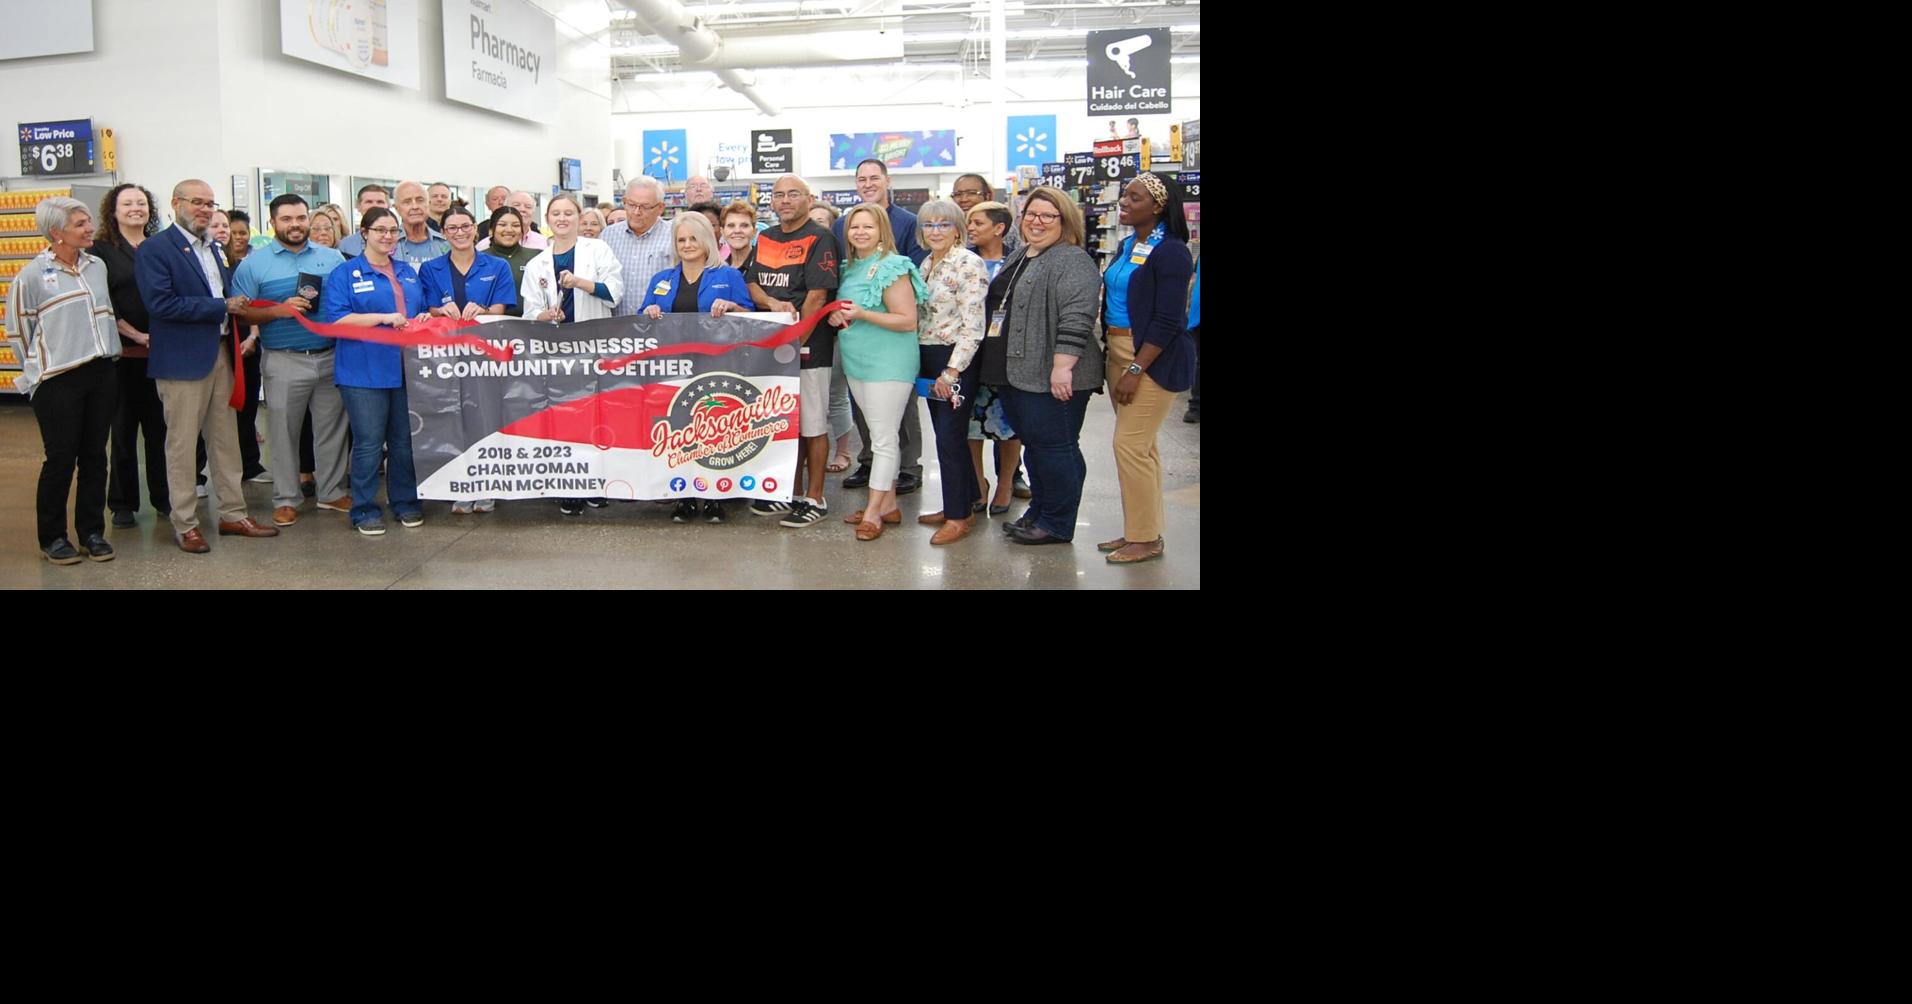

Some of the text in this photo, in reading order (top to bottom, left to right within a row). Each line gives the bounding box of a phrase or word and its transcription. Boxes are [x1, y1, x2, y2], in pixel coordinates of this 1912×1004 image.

[470, 14, 541, 84] Pharmacy
[471, 60, 507, 89] Farmacia
[1092, 85, 1167, 100] Hair Care
[1090, 103, 1123, 111] Cuidado
[1138, 101, 1169, 109] Cabello
[34, 132, 52, 140] Low
[53, 129, 75, 139] Price
[718, 143, 748, 154] Every
[529, 338, 658, 354] BUSINESSES
[436, 359, 576, 379] COMMUNITY
[651, 385, 797, 458] Jacksonville
[668, 443, 716, 469] Chamber
[731, 419, 789, 446] Commerce
[478, 446, 572, 460] 2018 & 2023
[708, 442, 759, 466] GROW HERE!
[467, 462, 589, 477] CHAIRWOMAN
[449, 478, 607, 494] BRITIAN MCKINNEY
